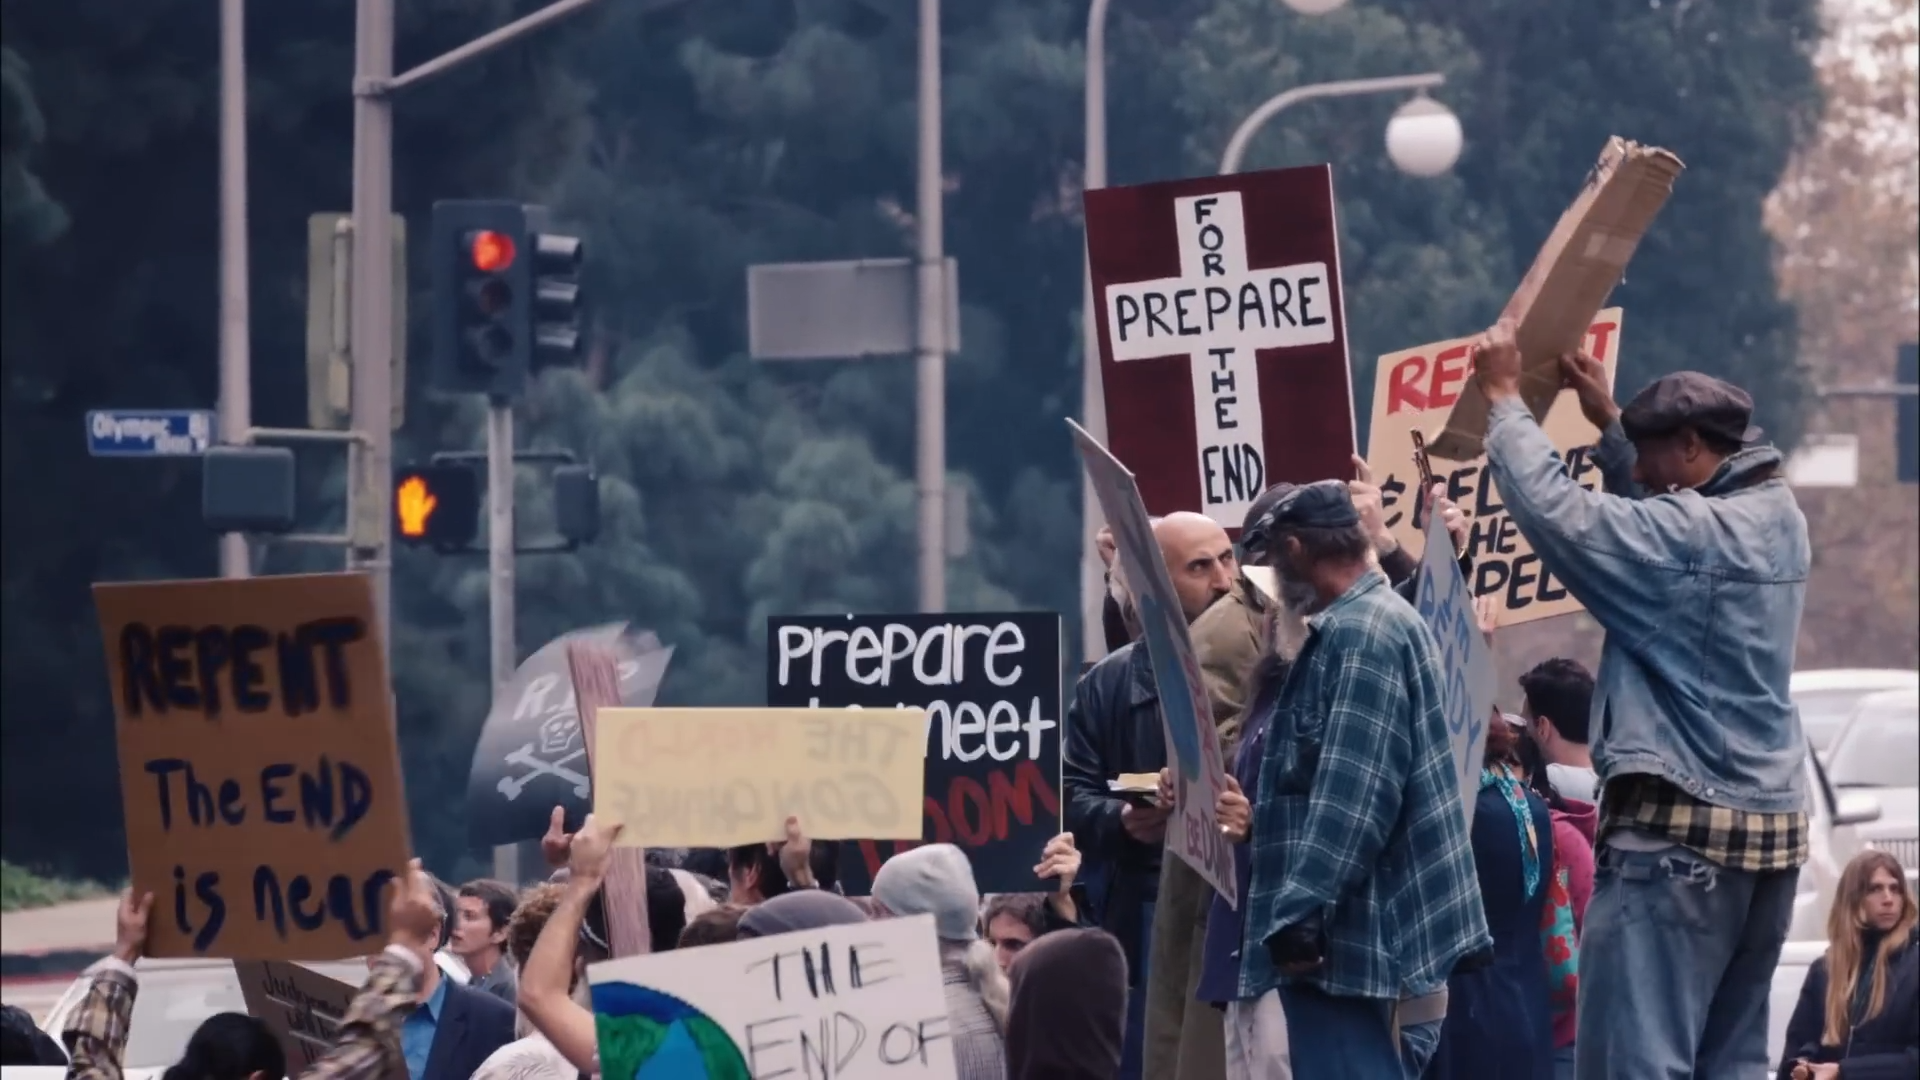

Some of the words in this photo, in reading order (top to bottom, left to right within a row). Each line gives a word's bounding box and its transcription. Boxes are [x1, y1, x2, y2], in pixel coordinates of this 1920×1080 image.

[1194, 198, 1225, 277] FOR
[1116, 276, 1326, 342] PREPARE
[1208, 347, 1238, 429] THE
[1387, 321, 1616, 416] RET
[1202, 443, 1263, 504] END
[1468, 516, 1517, 557] HE
[118, 616, 367, 720] REPENT
[144, 757, 246, 832] The
[260, 753, 372, 843] END
[173, 865, 225, 952] is
[253, 864, 398, 942] near
[746, 941, 903, 1001] THE
[745, 1011, 866, 1080] END
[878, 1016, 949, 1066] OF
